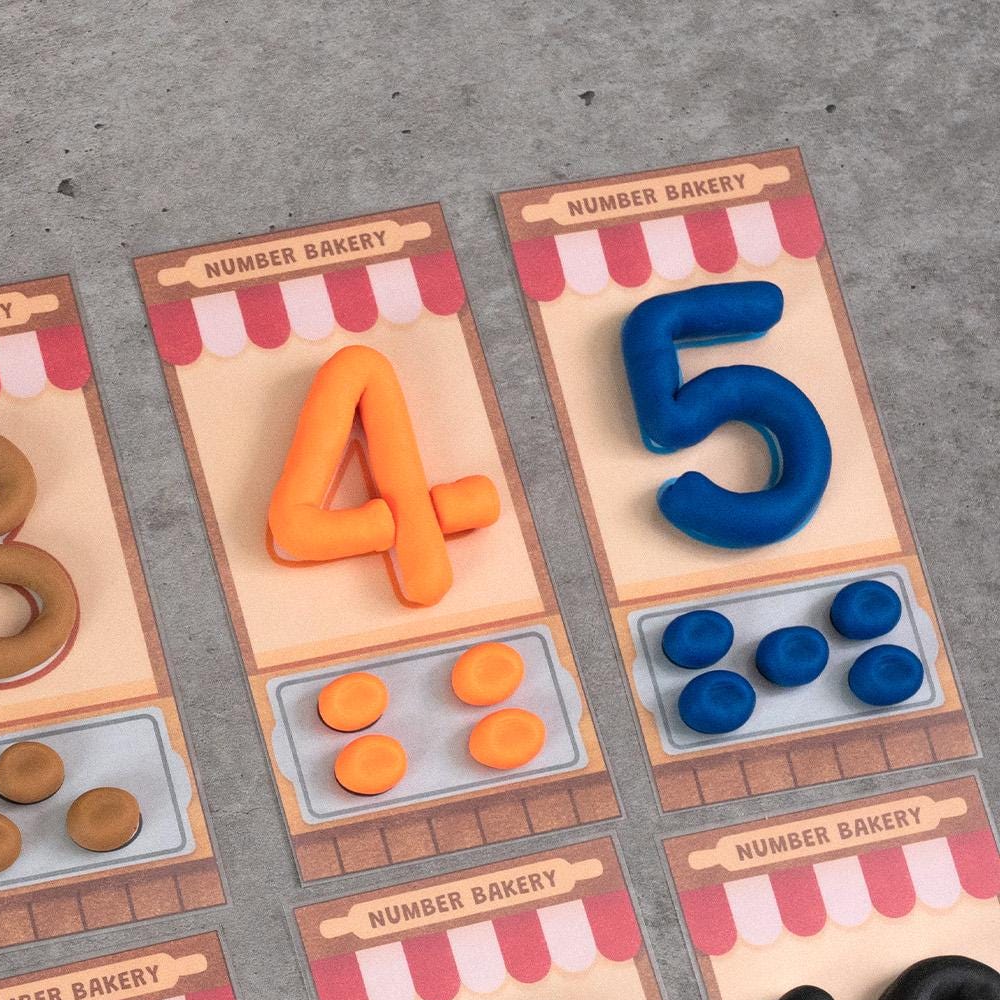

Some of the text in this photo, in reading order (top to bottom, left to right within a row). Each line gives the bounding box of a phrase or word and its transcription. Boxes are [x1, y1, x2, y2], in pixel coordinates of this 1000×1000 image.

[567, 173, 745, 217] NUMBER BAKERY
[203, 230, 386, 279] NUMBER BAKERY
[621, 280, 832, 550] 5
[266, 345, 501, 608] 4
[735, 807, 921, 861] NUMBER BAKERY
[368, 869, 556, 929] NUMBER BAKERY
[71, 964, 159, 1000] BAKERY
